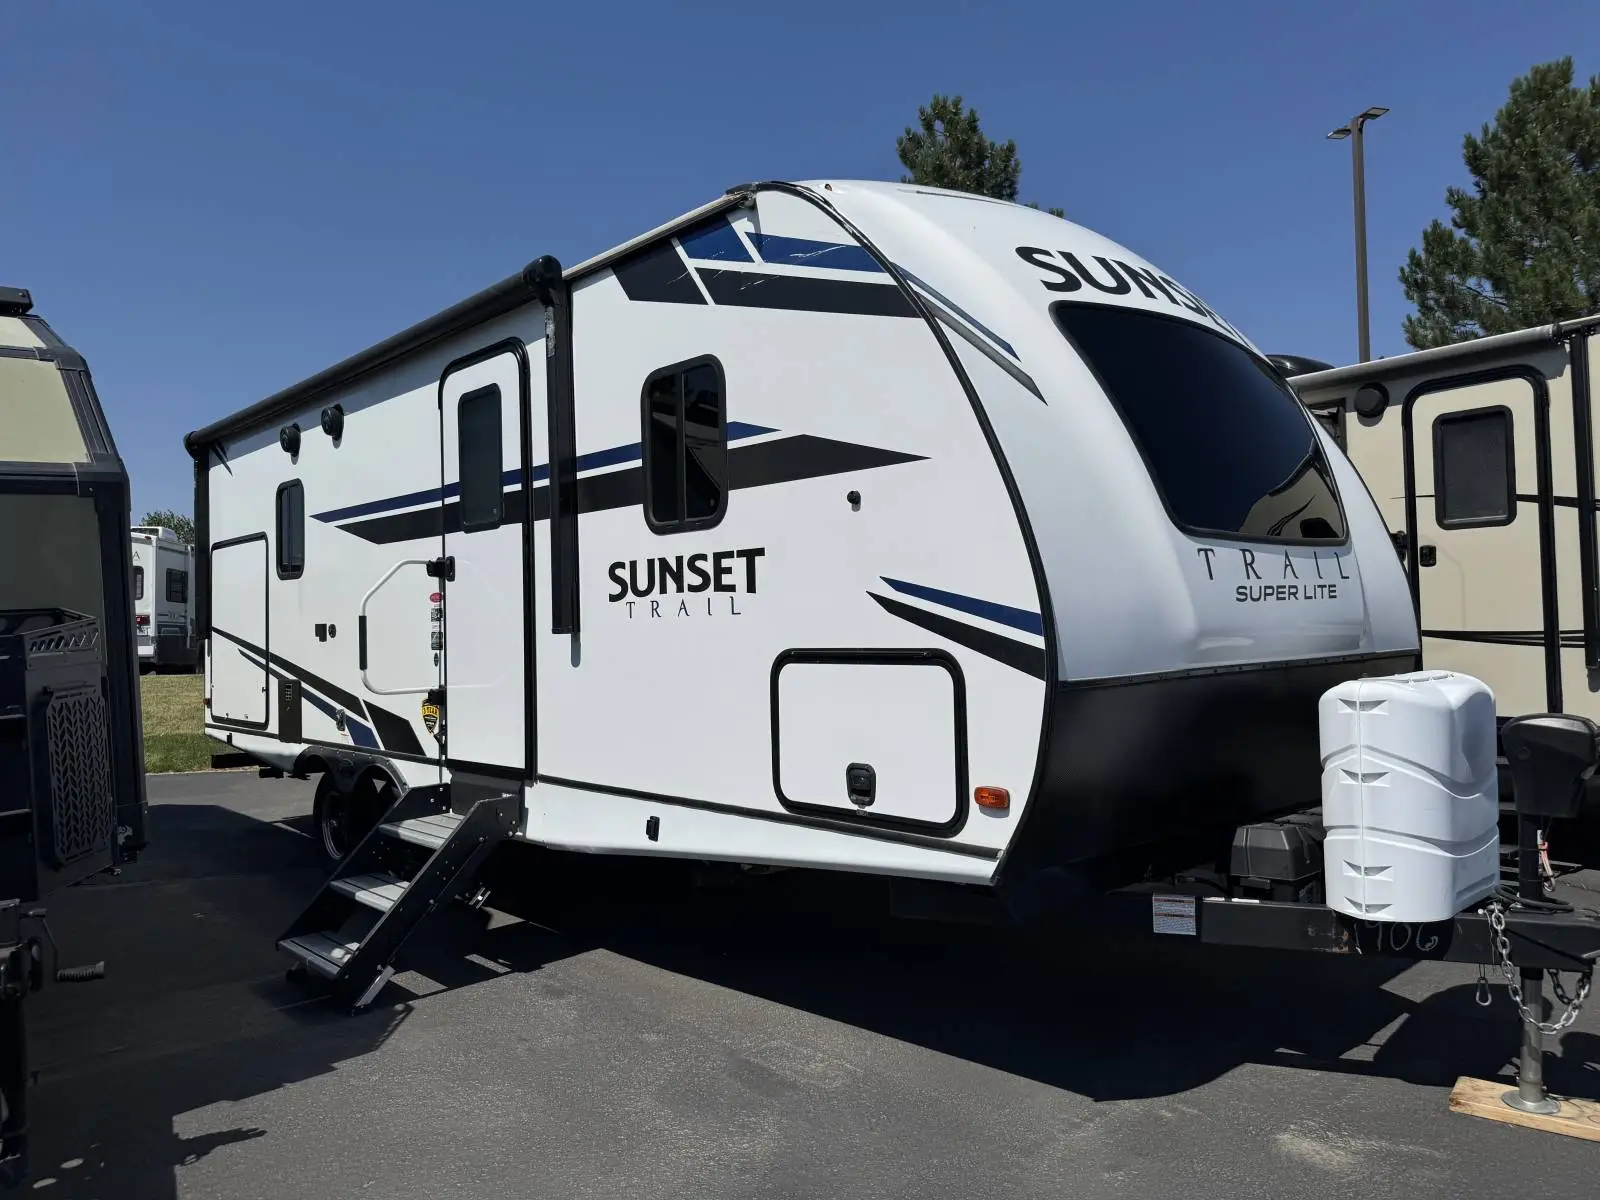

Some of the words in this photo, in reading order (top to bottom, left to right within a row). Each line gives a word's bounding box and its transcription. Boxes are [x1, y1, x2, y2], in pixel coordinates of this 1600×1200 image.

[608, 547, 766, 603] SUNSET
[1196, 548, 1350, 581] TRAIL
[625, 596, 742, 619] TRAIL
[1235, 585, 1300, 603] SUPER
[1303, 584, 1338, 600] LITE
